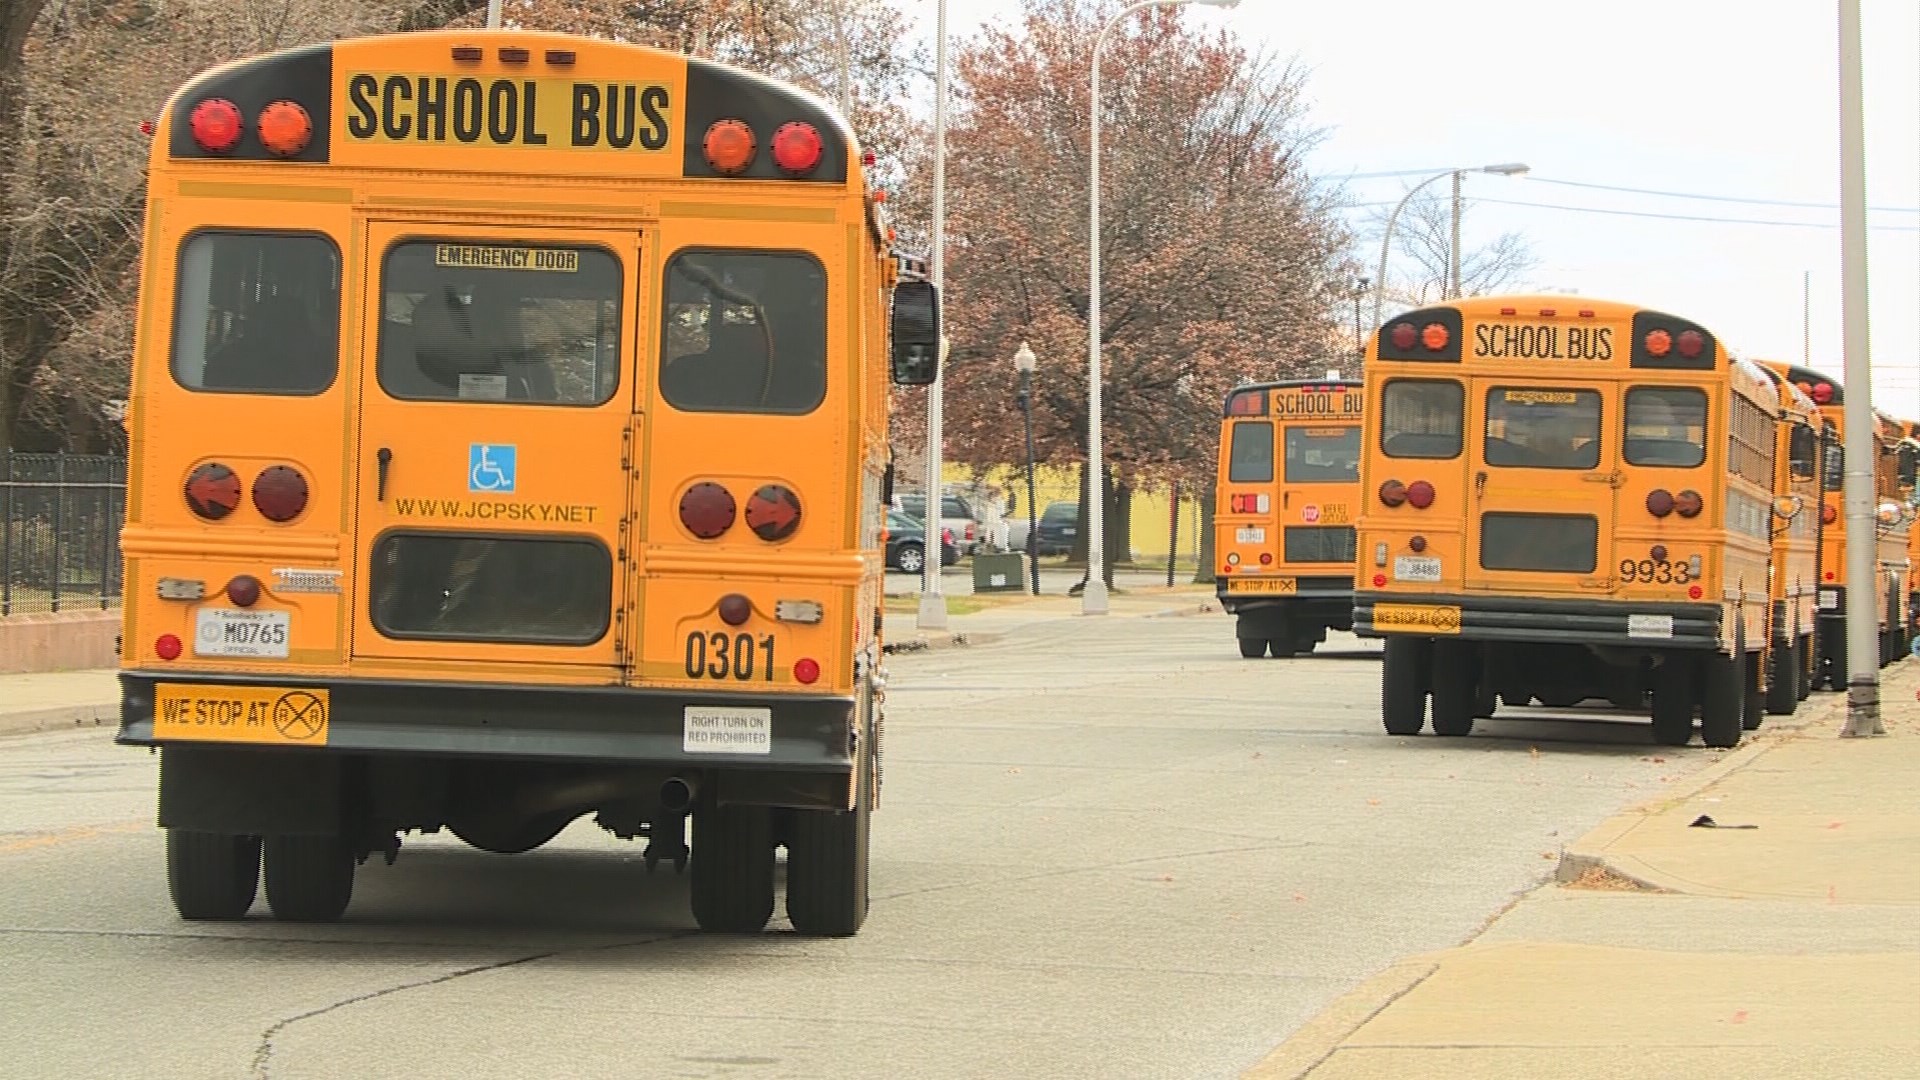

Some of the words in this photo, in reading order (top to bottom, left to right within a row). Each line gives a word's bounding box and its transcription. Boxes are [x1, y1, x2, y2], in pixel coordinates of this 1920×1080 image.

[349, 73, 547, 145] SCHOOL
[571, 82, 669, 150] BUS
[438, 246, 529, 267] EMERGENCY
[535, 251, 575, 269] DOOR
[1475, 323, 1563, 358] SCHOOL
[1567, 327, 1612, 360] BUS
[1276, 393, 1335, 413] SCHOOL
[1343, 393, 1363, 413] BU
[396, 498, 597, 523] WWW.JCPSKY.NET
[1620, 559, 1689, 584] 9933
[222, 609, 264, 621] Kentucky
[224, 622, 285, 644] M0765
[685, 630, 775, 682] 0301
[163, 699, 191, 724] WE
[195, 699, 243, 726] STOP
[247, 701, 270, 727] AT
[691, 716, 719, 728] RIGHT
[722, 716, 748, 728] TURN
[749, 716, 764, 728] ON
[688, 730, 708, 742] RED
[710, 731, 766, 744] PROHIBITED
